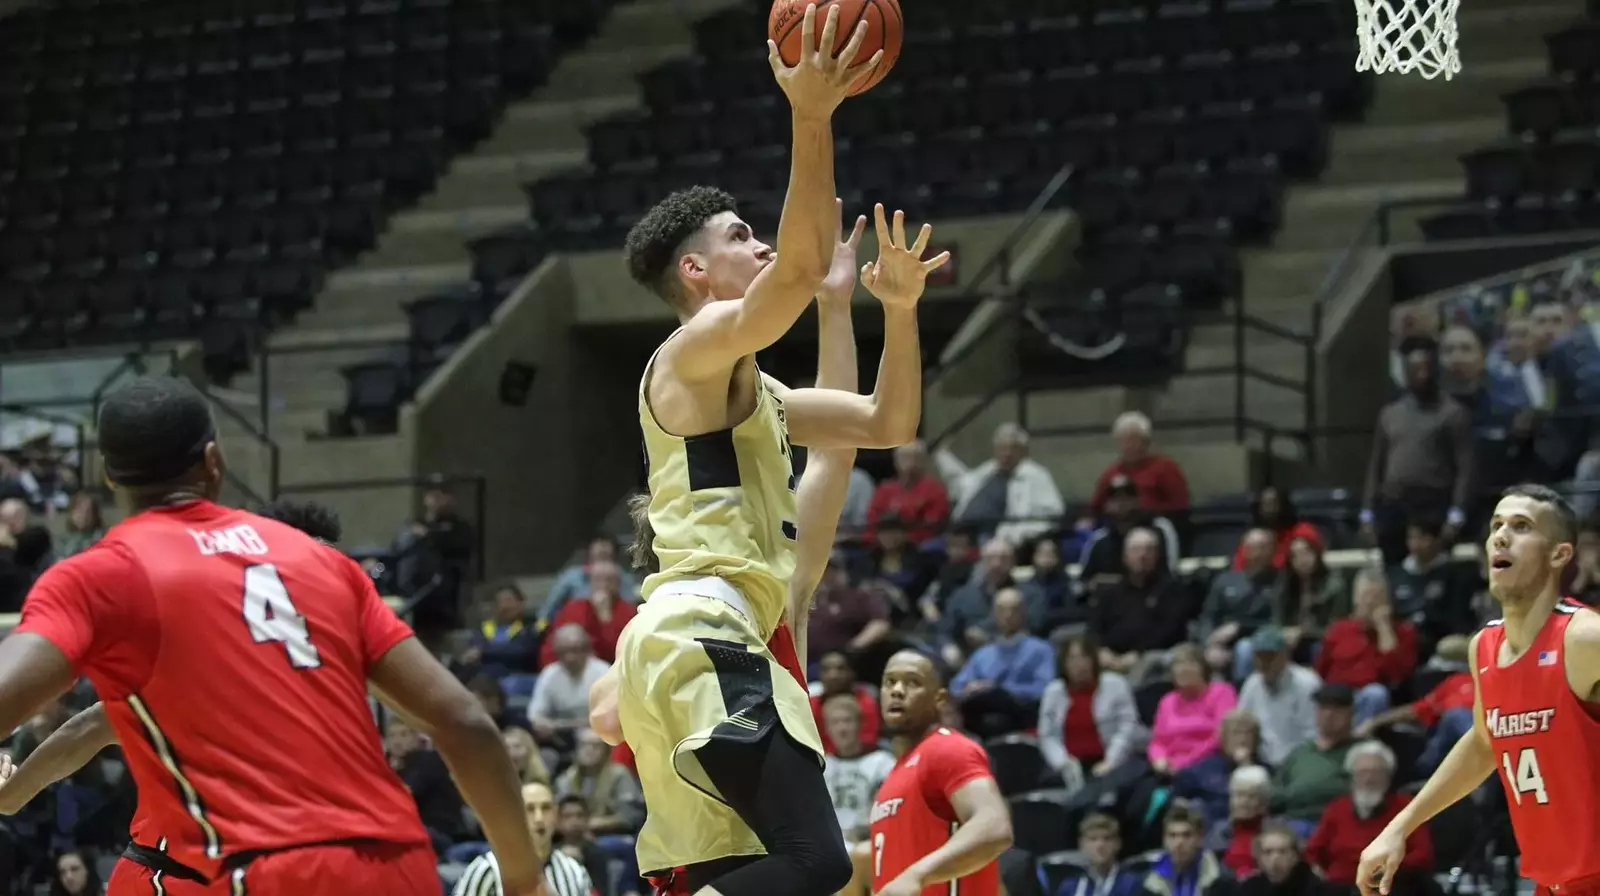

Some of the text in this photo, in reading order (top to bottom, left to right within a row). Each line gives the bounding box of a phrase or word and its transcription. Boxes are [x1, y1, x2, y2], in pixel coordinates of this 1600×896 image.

[242, 563, 322, 669] 4
[1486, 707, 1556, 738] MARIST
[1502, 748, 1550, 806] 14
